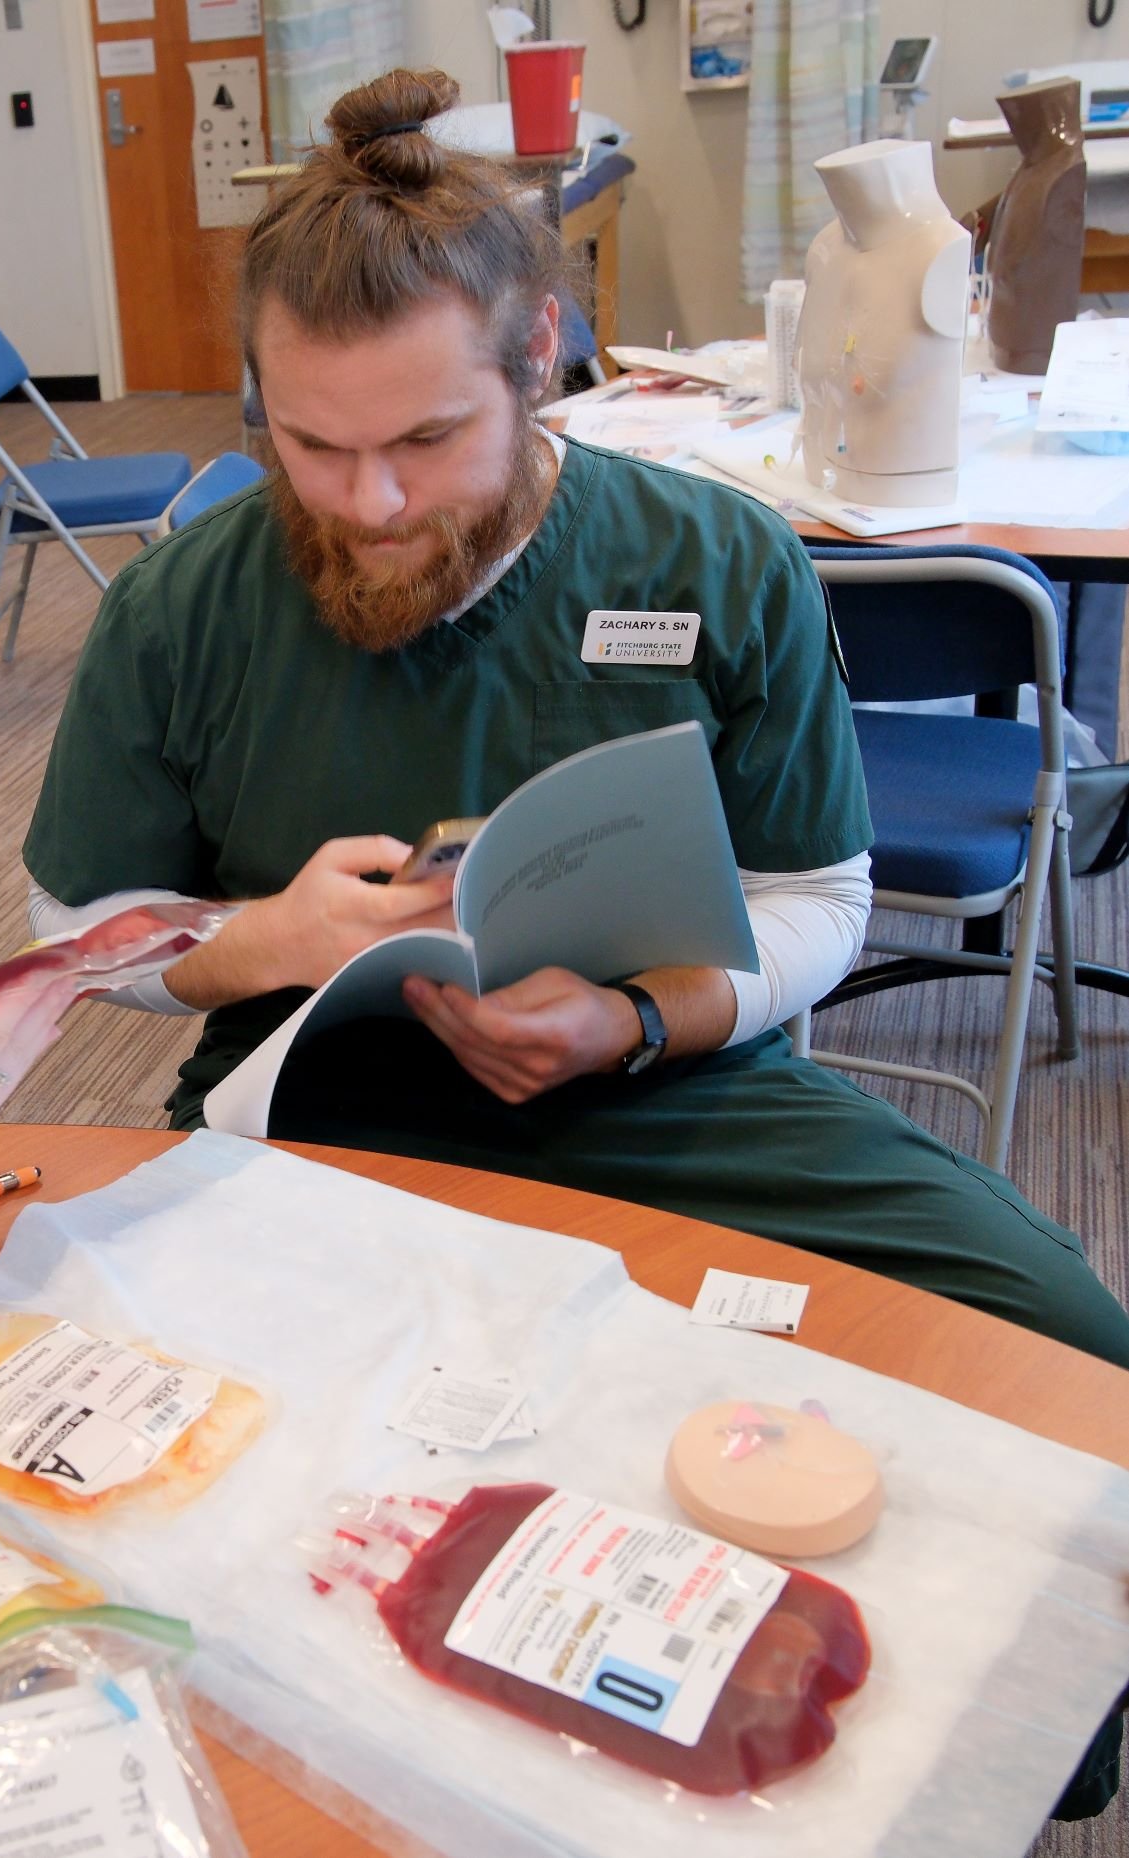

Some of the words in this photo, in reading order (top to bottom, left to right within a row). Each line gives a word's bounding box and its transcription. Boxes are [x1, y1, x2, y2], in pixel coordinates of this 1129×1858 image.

[599, 620, 656, 630] ZACHARY
[658, 621, 669, 631] S.
[672, 621, 689, 631] SN
[615, 649, 681, 658] UNIVERSITY
[141, 1376, 182, 1411] PLASMA
[38, 1451, 86, 1484] A
[567, 1629, 610, 1689] POSITIVE
